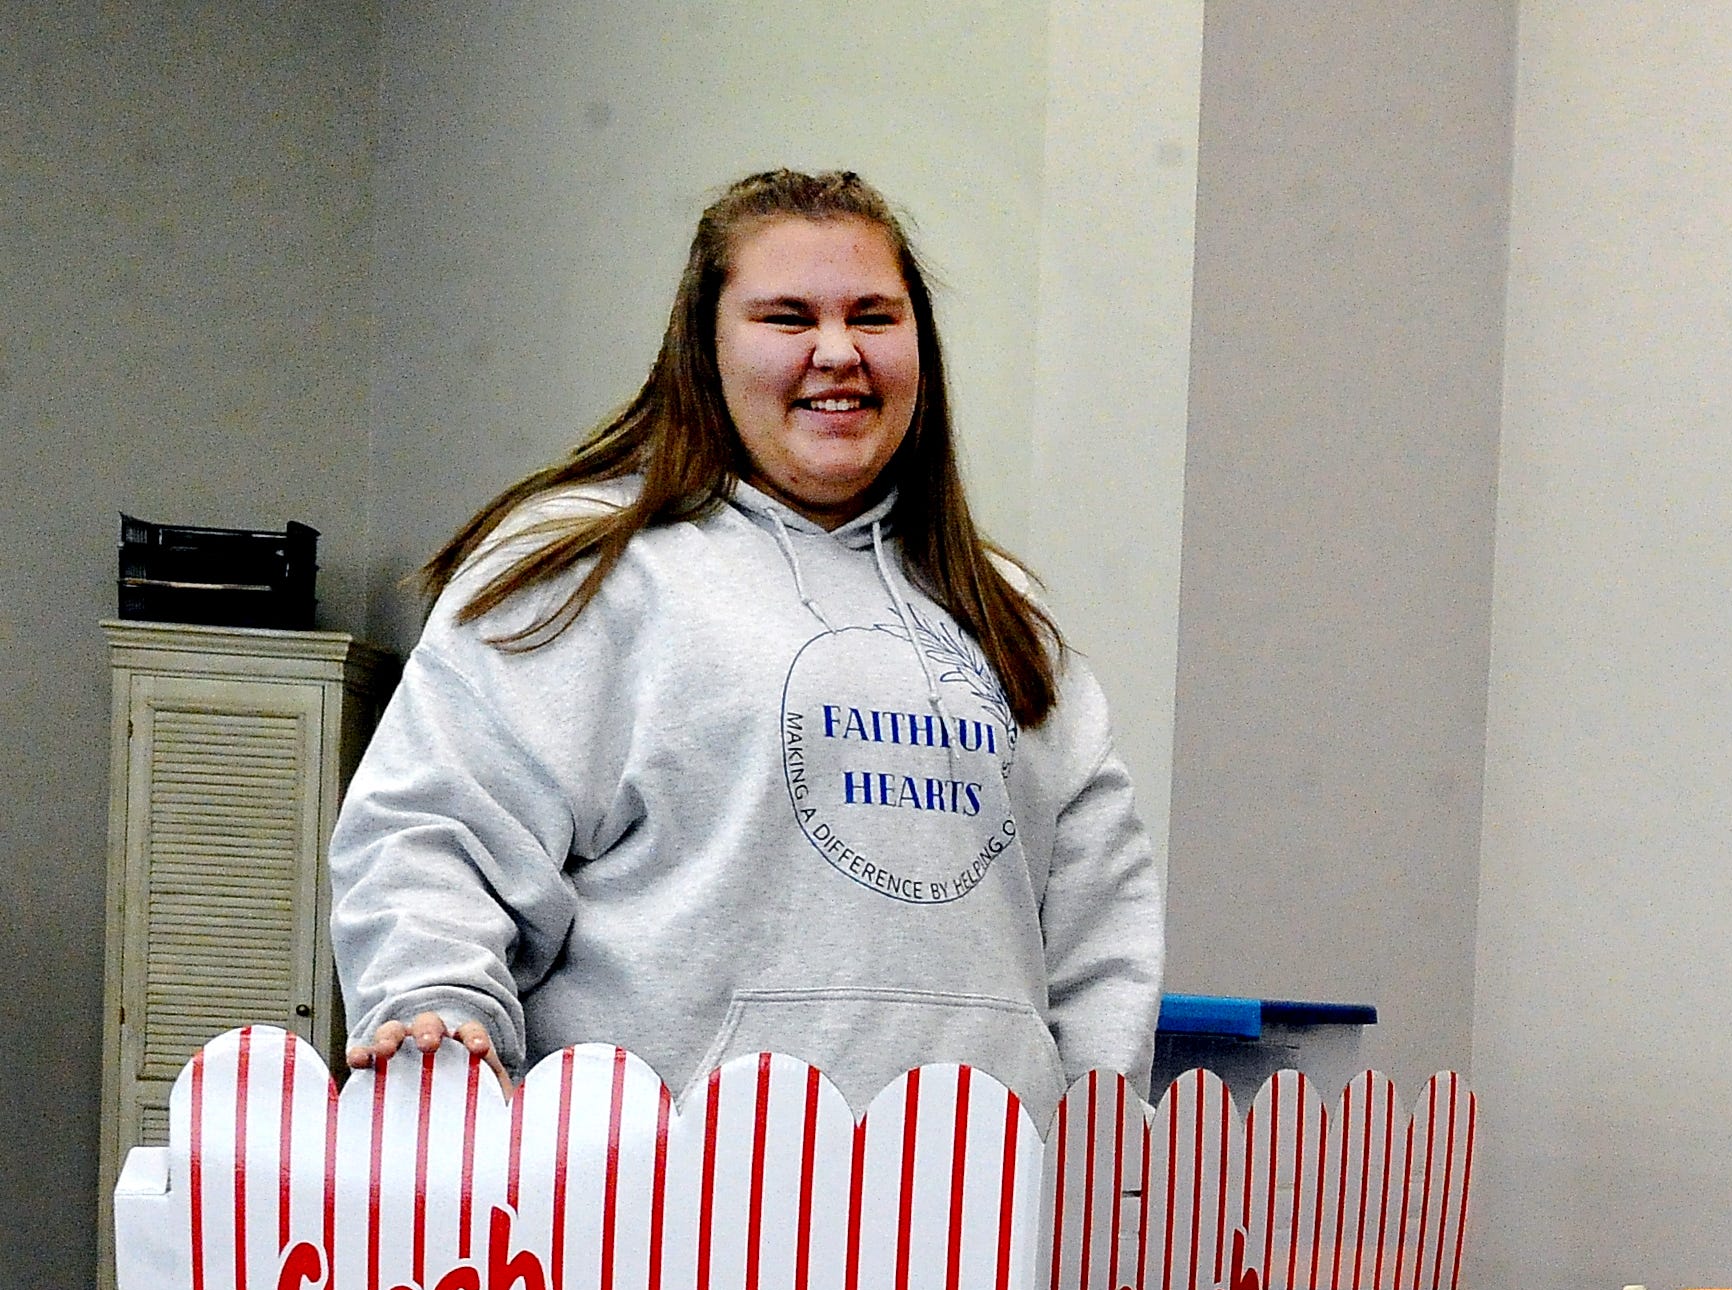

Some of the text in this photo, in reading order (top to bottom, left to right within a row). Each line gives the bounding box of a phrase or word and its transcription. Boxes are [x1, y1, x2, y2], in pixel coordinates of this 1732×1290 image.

[787, 711, 1004, 900] MAKING A DIFFERENCE BY HELPING
[844, 771, 982, 817] HEARTS
